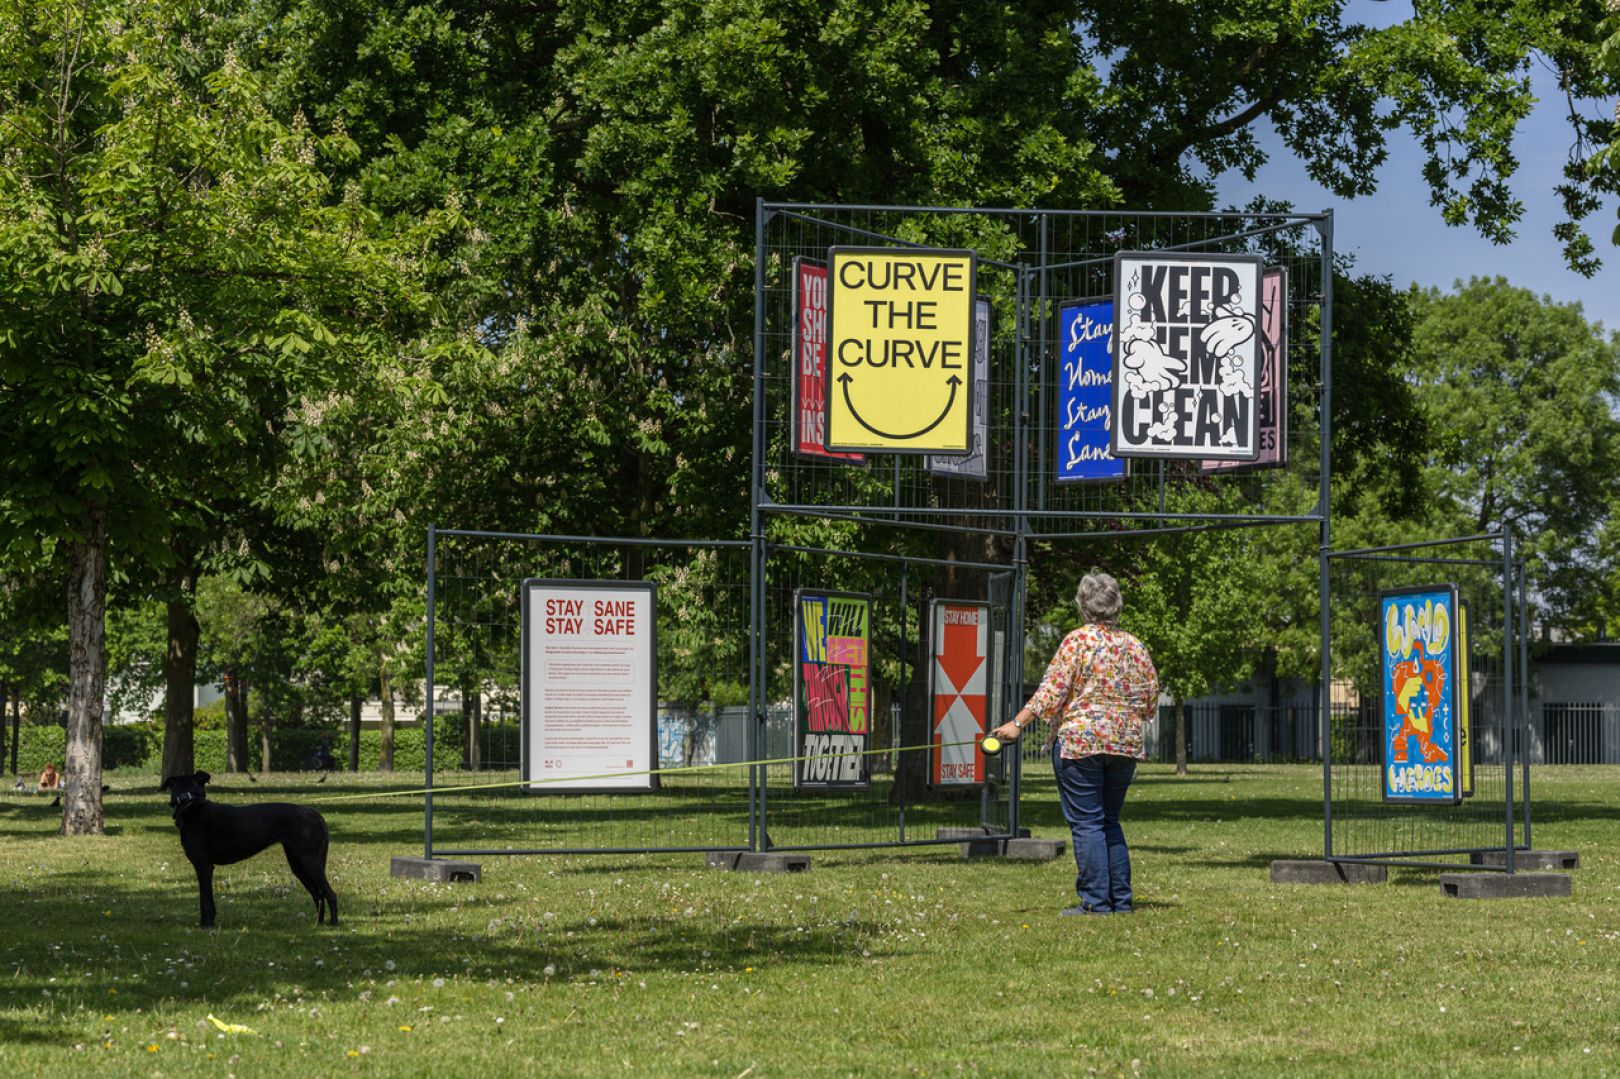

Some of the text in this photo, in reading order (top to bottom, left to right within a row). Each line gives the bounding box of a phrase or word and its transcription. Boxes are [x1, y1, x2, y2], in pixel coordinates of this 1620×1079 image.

[840, 261, 964, 291] CURVE
[1140, 265, 1240, 323] KEEP
[864, 300, 937, 329] THE
[1068, 313, 1114, 353] Stay
[803, 342, 821, 377] BE
[838, 338, 962, 369] CURVE
[1064, 397, 1111, 431] Stay
[1122, 388, 1249, 448] CLEAN
[546, 599, 635, 617] STAY SANE
[828, 602, 865, 637] WILL
[943, 610, 978, 625] STAY HOME
[546, 617, 635, 635] STAY SAFE
[801, 600, 826, 662] WE
[942, 763, 975, 778] STAY SAFE
